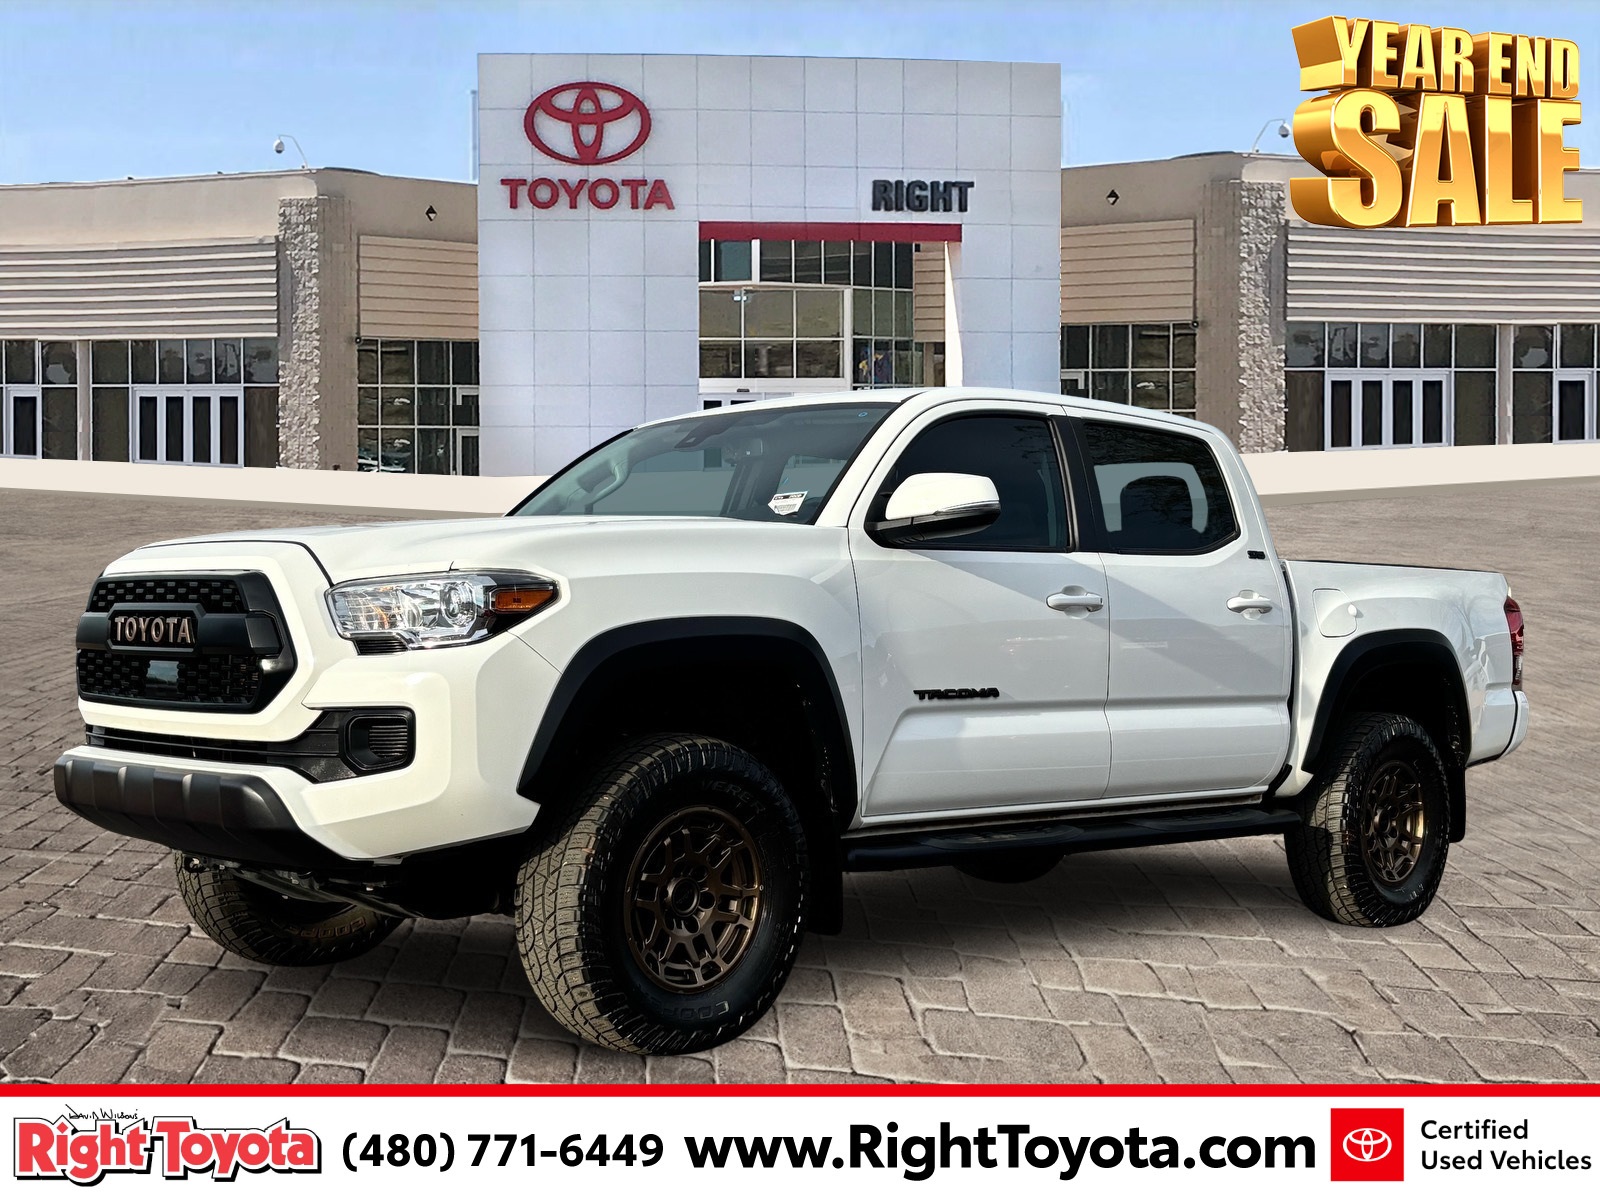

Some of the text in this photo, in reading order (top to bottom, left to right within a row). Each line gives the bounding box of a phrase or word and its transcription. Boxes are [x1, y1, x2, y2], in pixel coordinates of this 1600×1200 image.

[501, 178, 675, 210] TOYOTA
[871, 178, 975, 213] RIGHT
[114, 615, 195, 644] TOYOTA
[913, 687, 1000, 701] TACOMA
